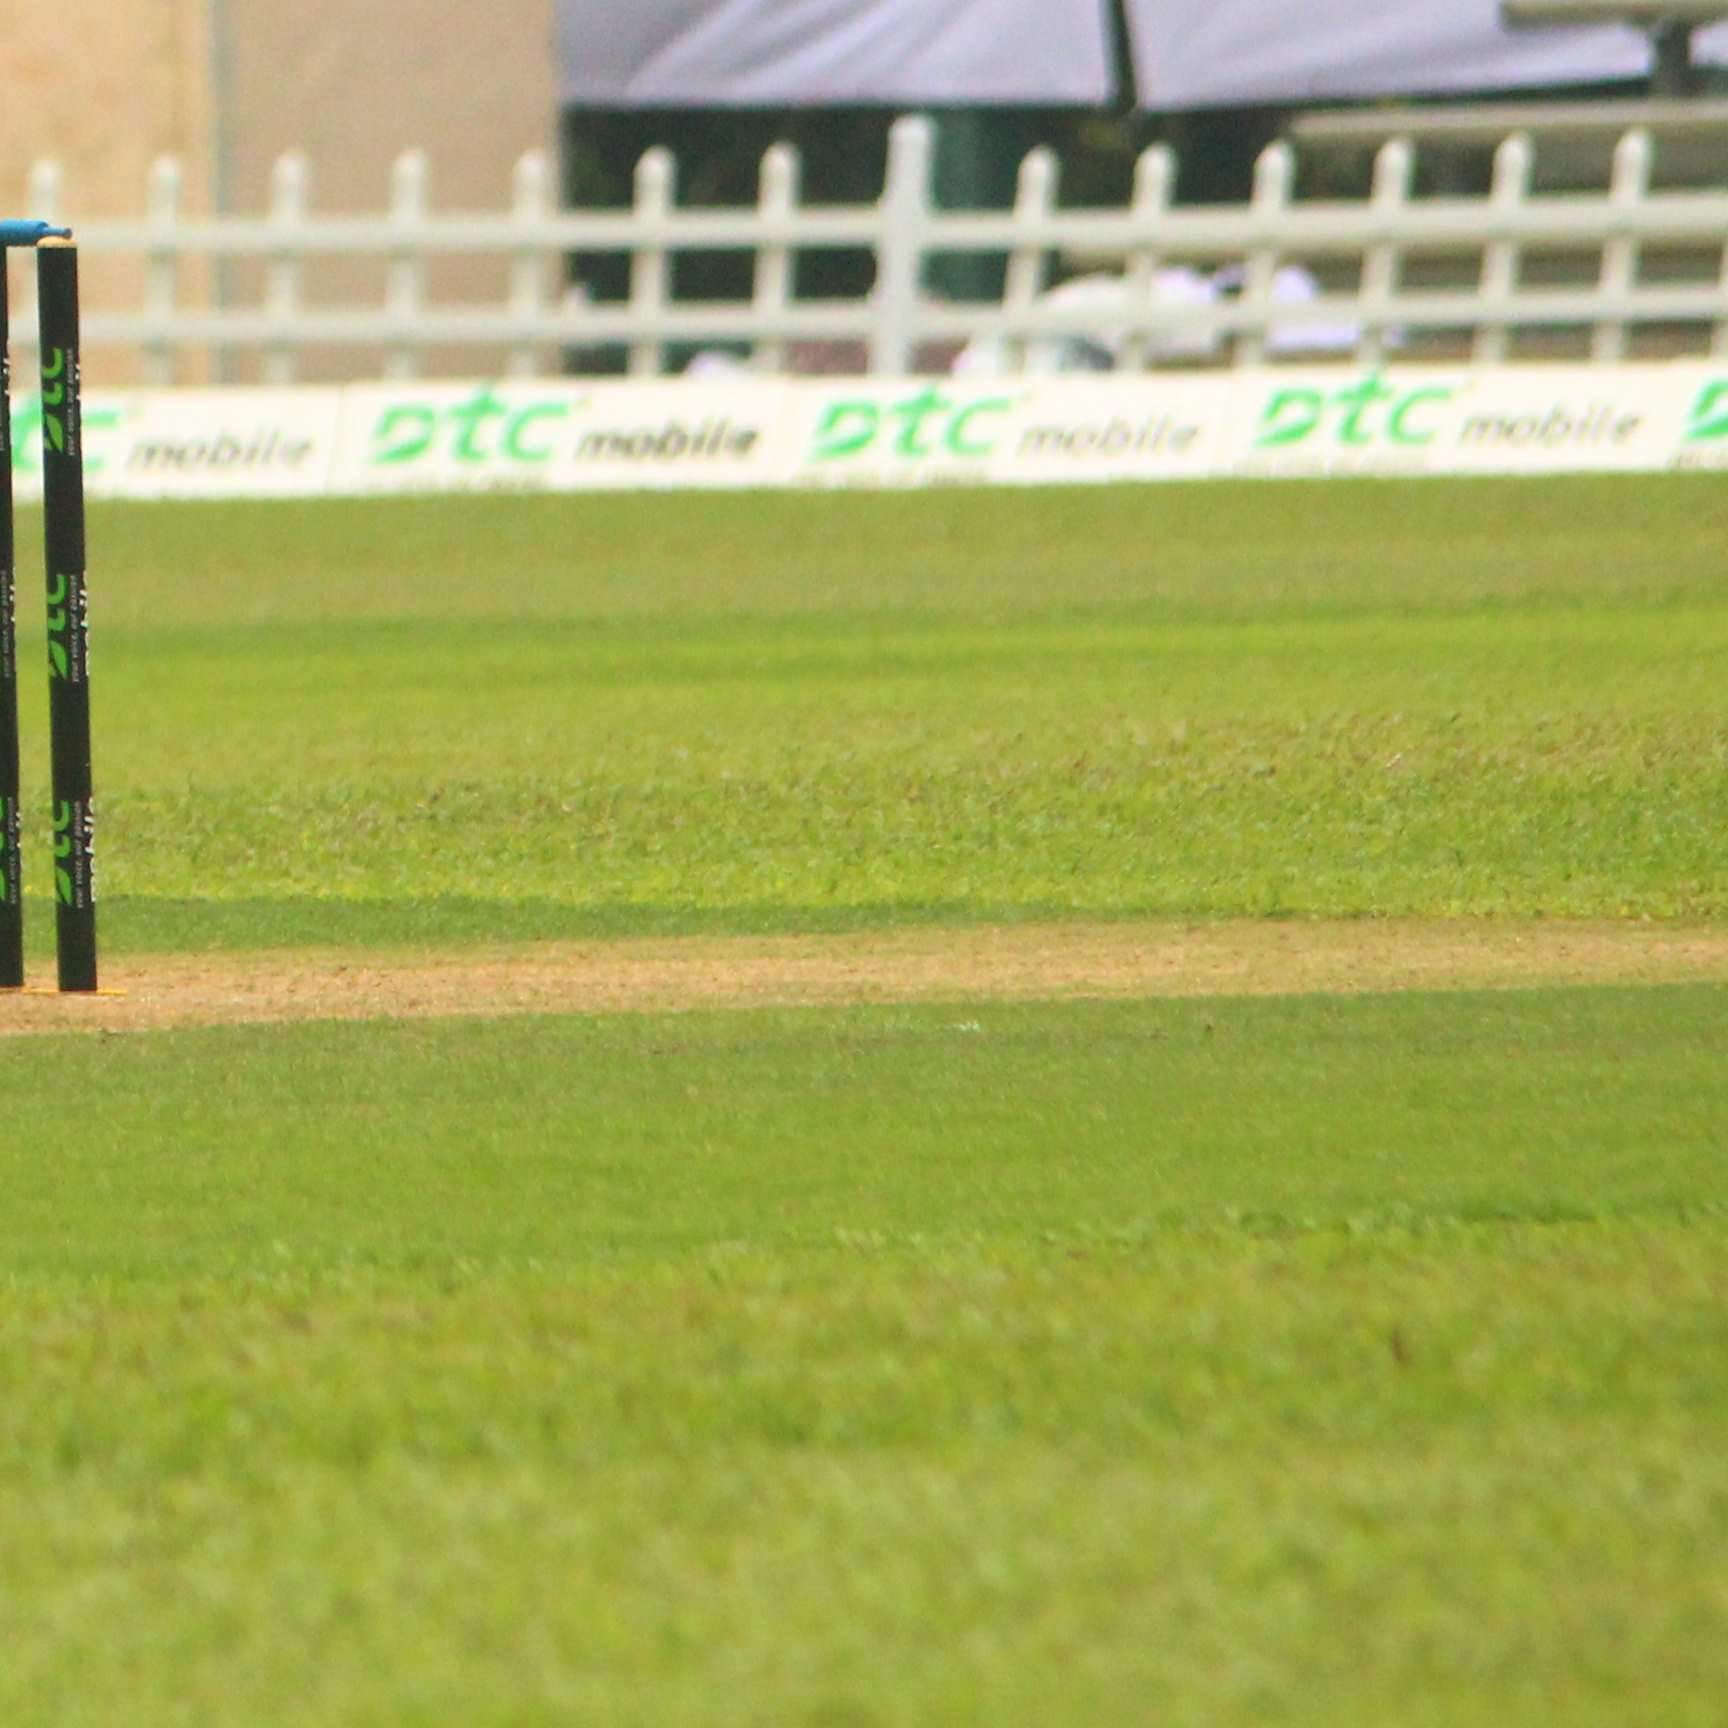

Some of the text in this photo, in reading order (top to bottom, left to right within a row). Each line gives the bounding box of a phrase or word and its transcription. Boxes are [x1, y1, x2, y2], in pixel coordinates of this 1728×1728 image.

[129, 423, 315, 469] mobile
[576, 419, 760, 464] mobile
[1018, 413, 1198, 459] mobile
[1459, 407, 1643, 448] mobile
